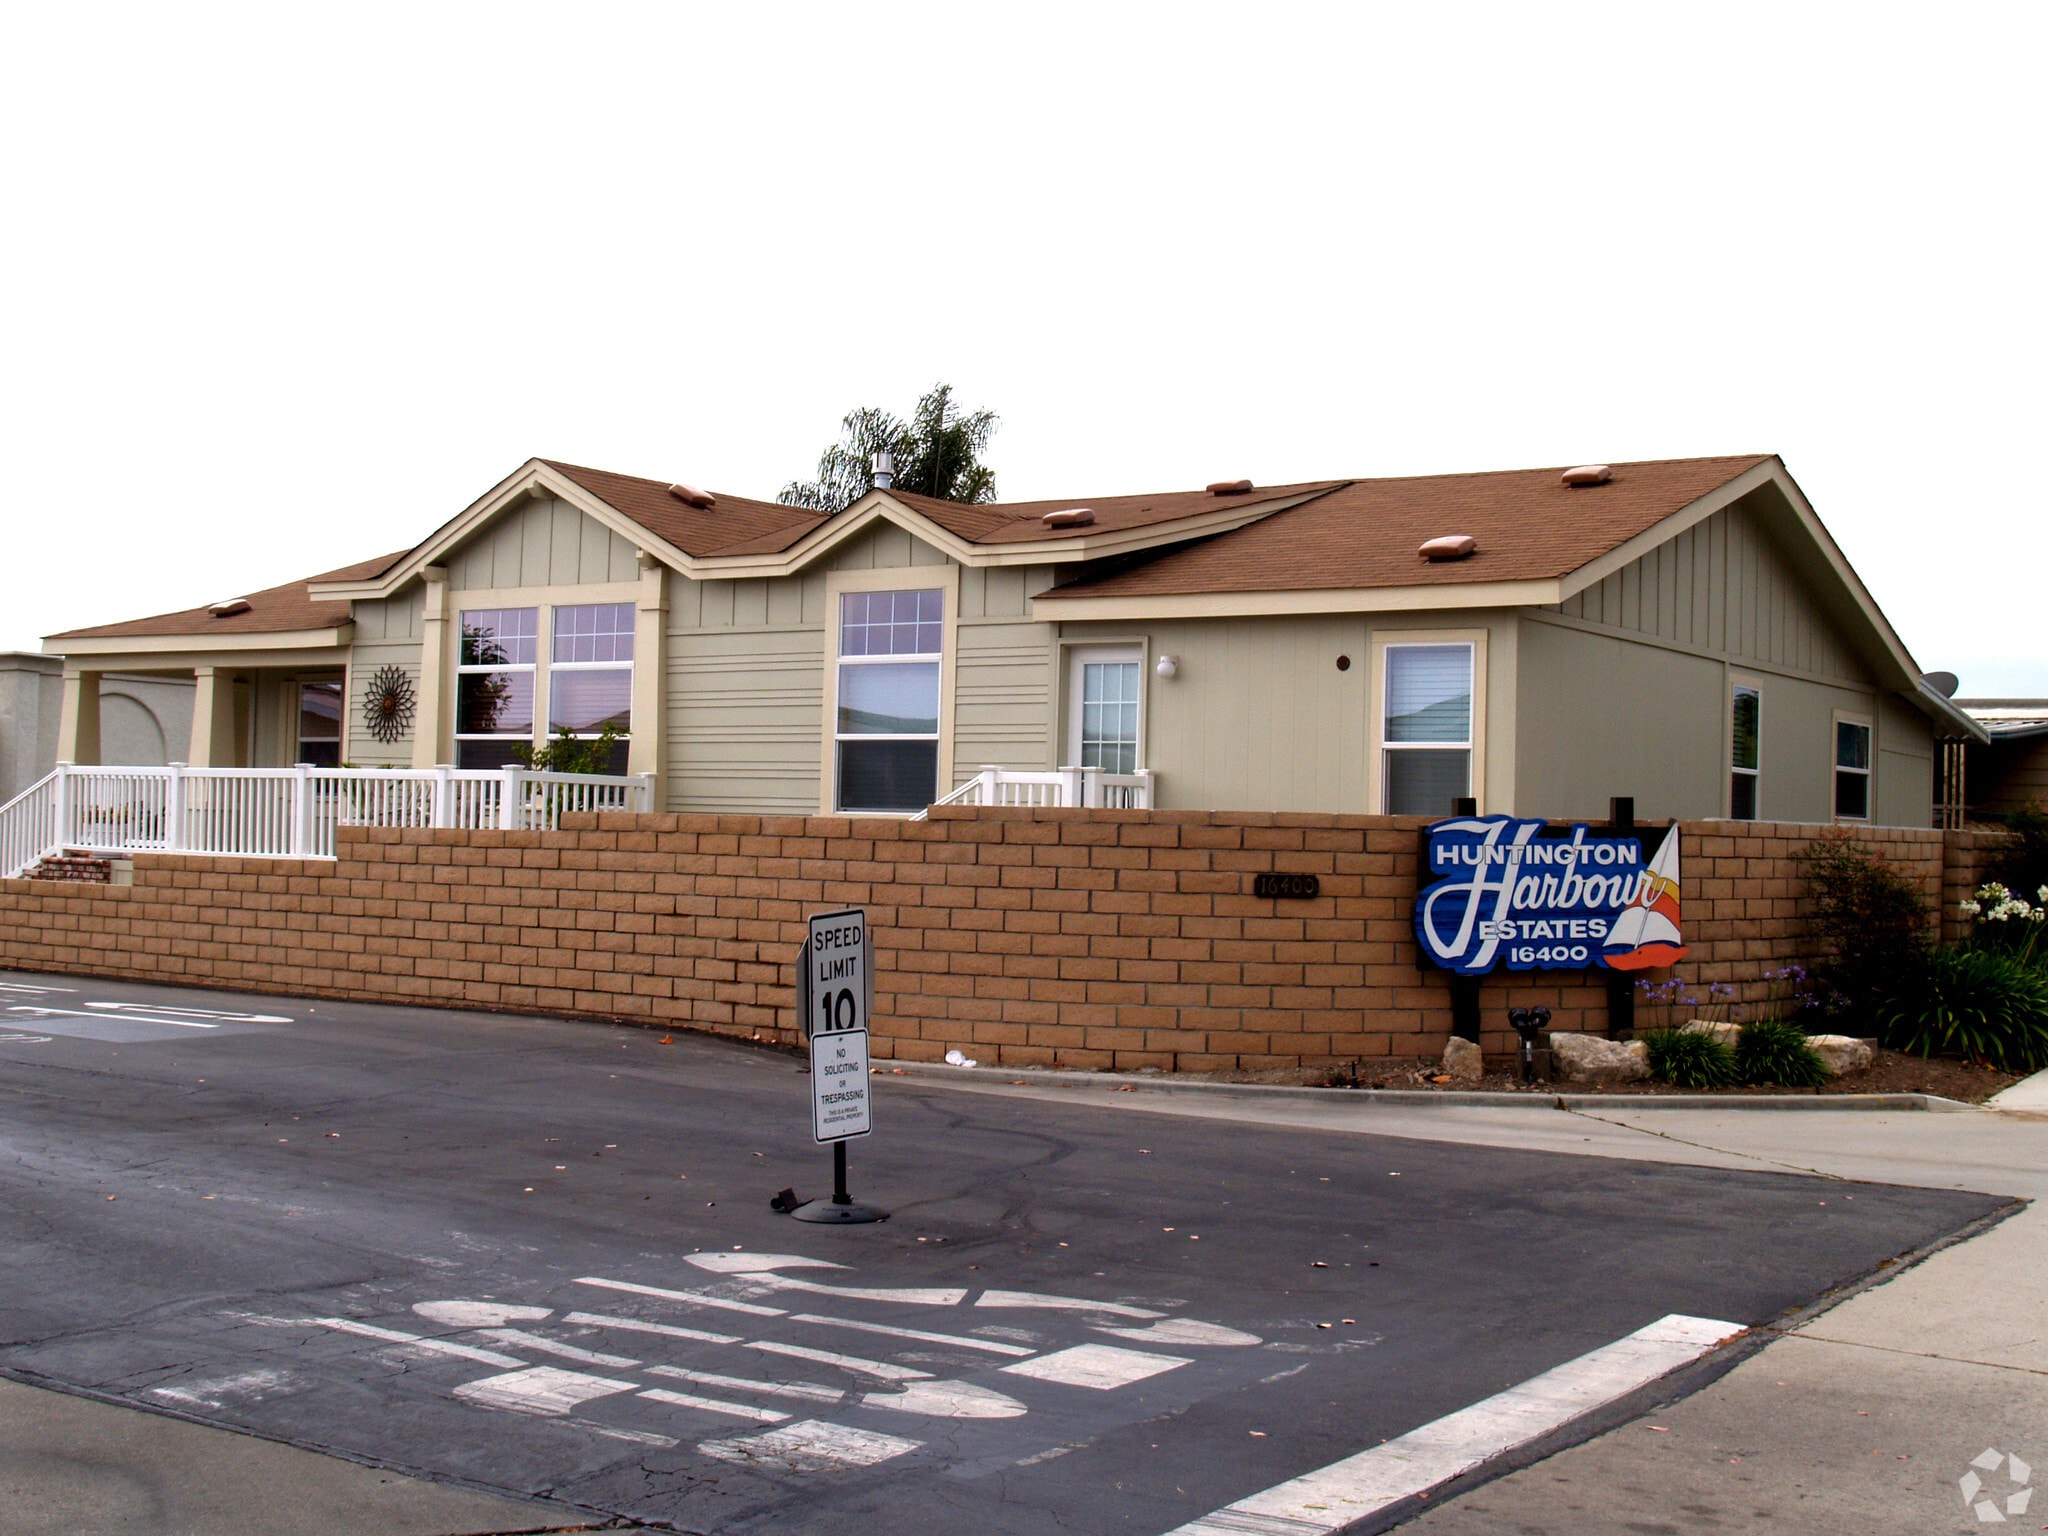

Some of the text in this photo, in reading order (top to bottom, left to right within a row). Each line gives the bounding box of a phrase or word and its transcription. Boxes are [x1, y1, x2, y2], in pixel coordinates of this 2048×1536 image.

[1436, 844, 1637, 866] HUNTINGTON
[1261, 877, 1315, 894] 16400
[1423, 819, 1667, 969] Harbour
[814, 925, 862, 952] SPEED
[1478, 918, 1608, 941] ESTATES
[1510, 945, 1589, 963] 16400
[820, 957, 857, 982] LIMIT
[822, 987, 856, 1032] 10
[836, 1048, 846, 1058] NO
[824, 1062, 859, 1076] SOLICITING
[838, 1080, 846, 1088] OR
[821, 1089, 864, 1105] TRESPASSING
